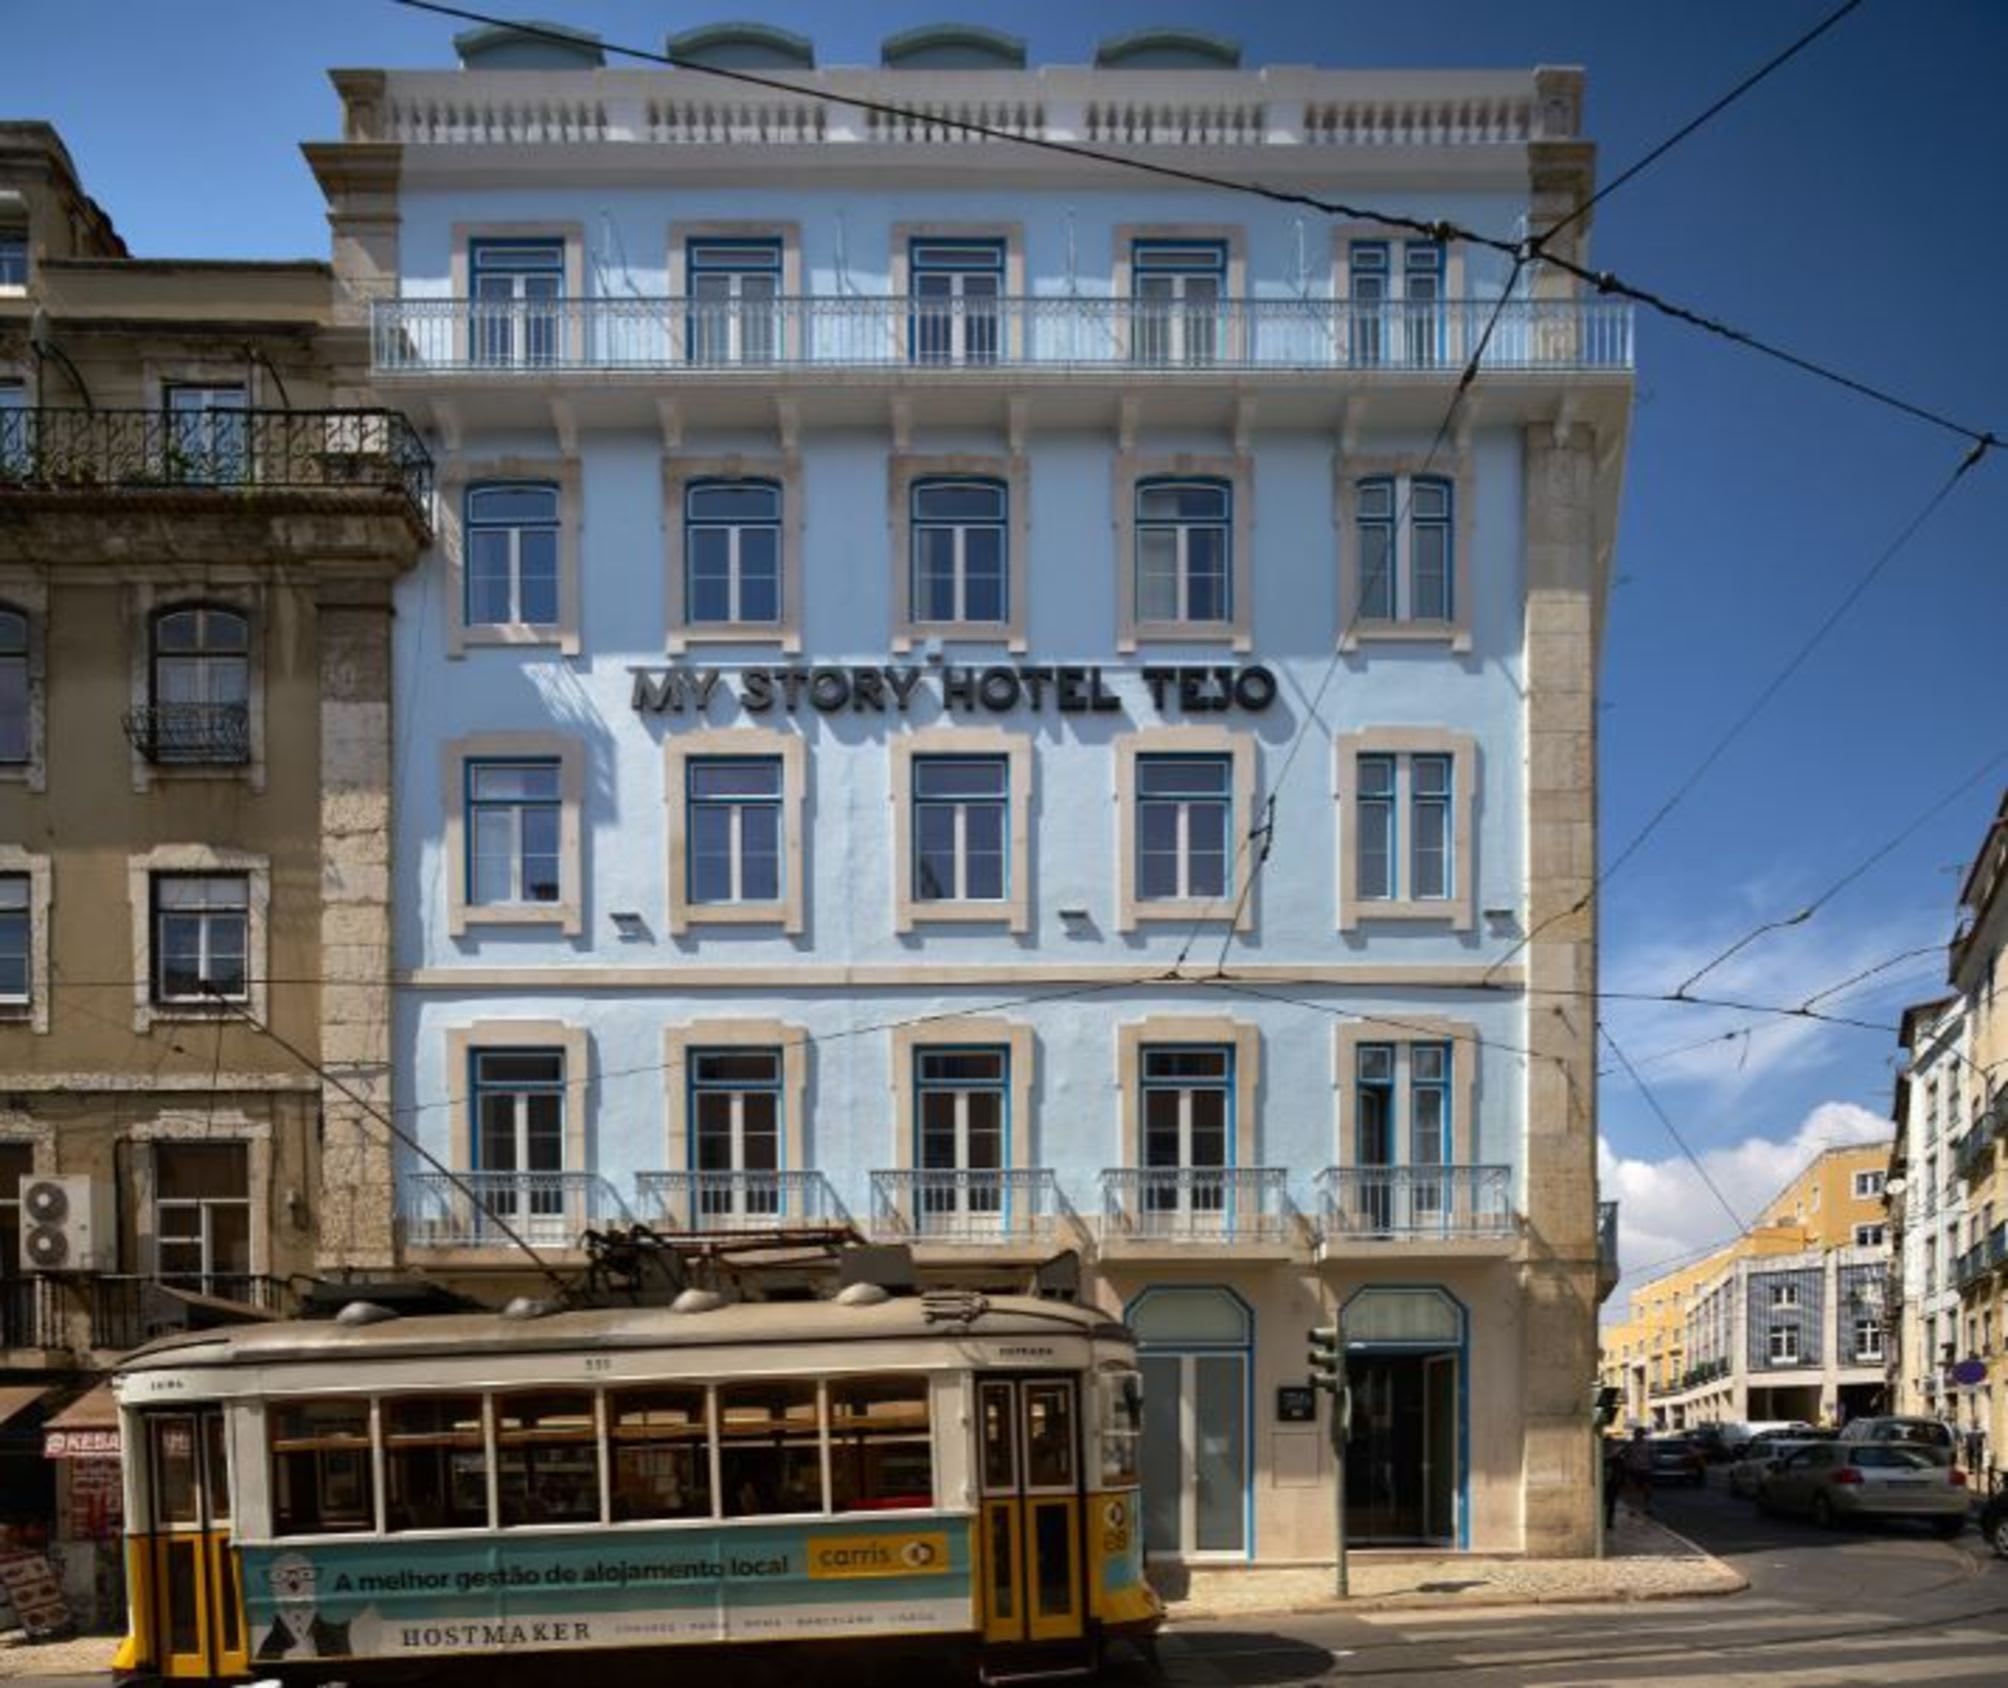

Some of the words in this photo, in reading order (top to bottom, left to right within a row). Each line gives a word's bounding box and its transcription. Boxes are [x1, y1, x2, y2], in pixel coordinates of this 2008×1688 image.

[631, 666, 719, 712] MY
[741, 665, 921, 712] STORY
[943, 665, 1121, 712] HOTEL
[1142, 665, 1277, 712] TEJO
[66, 1432, 120, 1450] KEBA
[819, 1541, 890, 1566] carris
[335, 1572, 352, 1592] A
[359, 1569, 449, 1591] melhor
[455, 1564, 540, 1590] gestão
[545, 1564, 577, 1584] de
[583, 1560, 725, 1587] alojamento
[731, 1556, 788, 1577] local
[402, 1621, 592, 1648] HOSTMAKER
